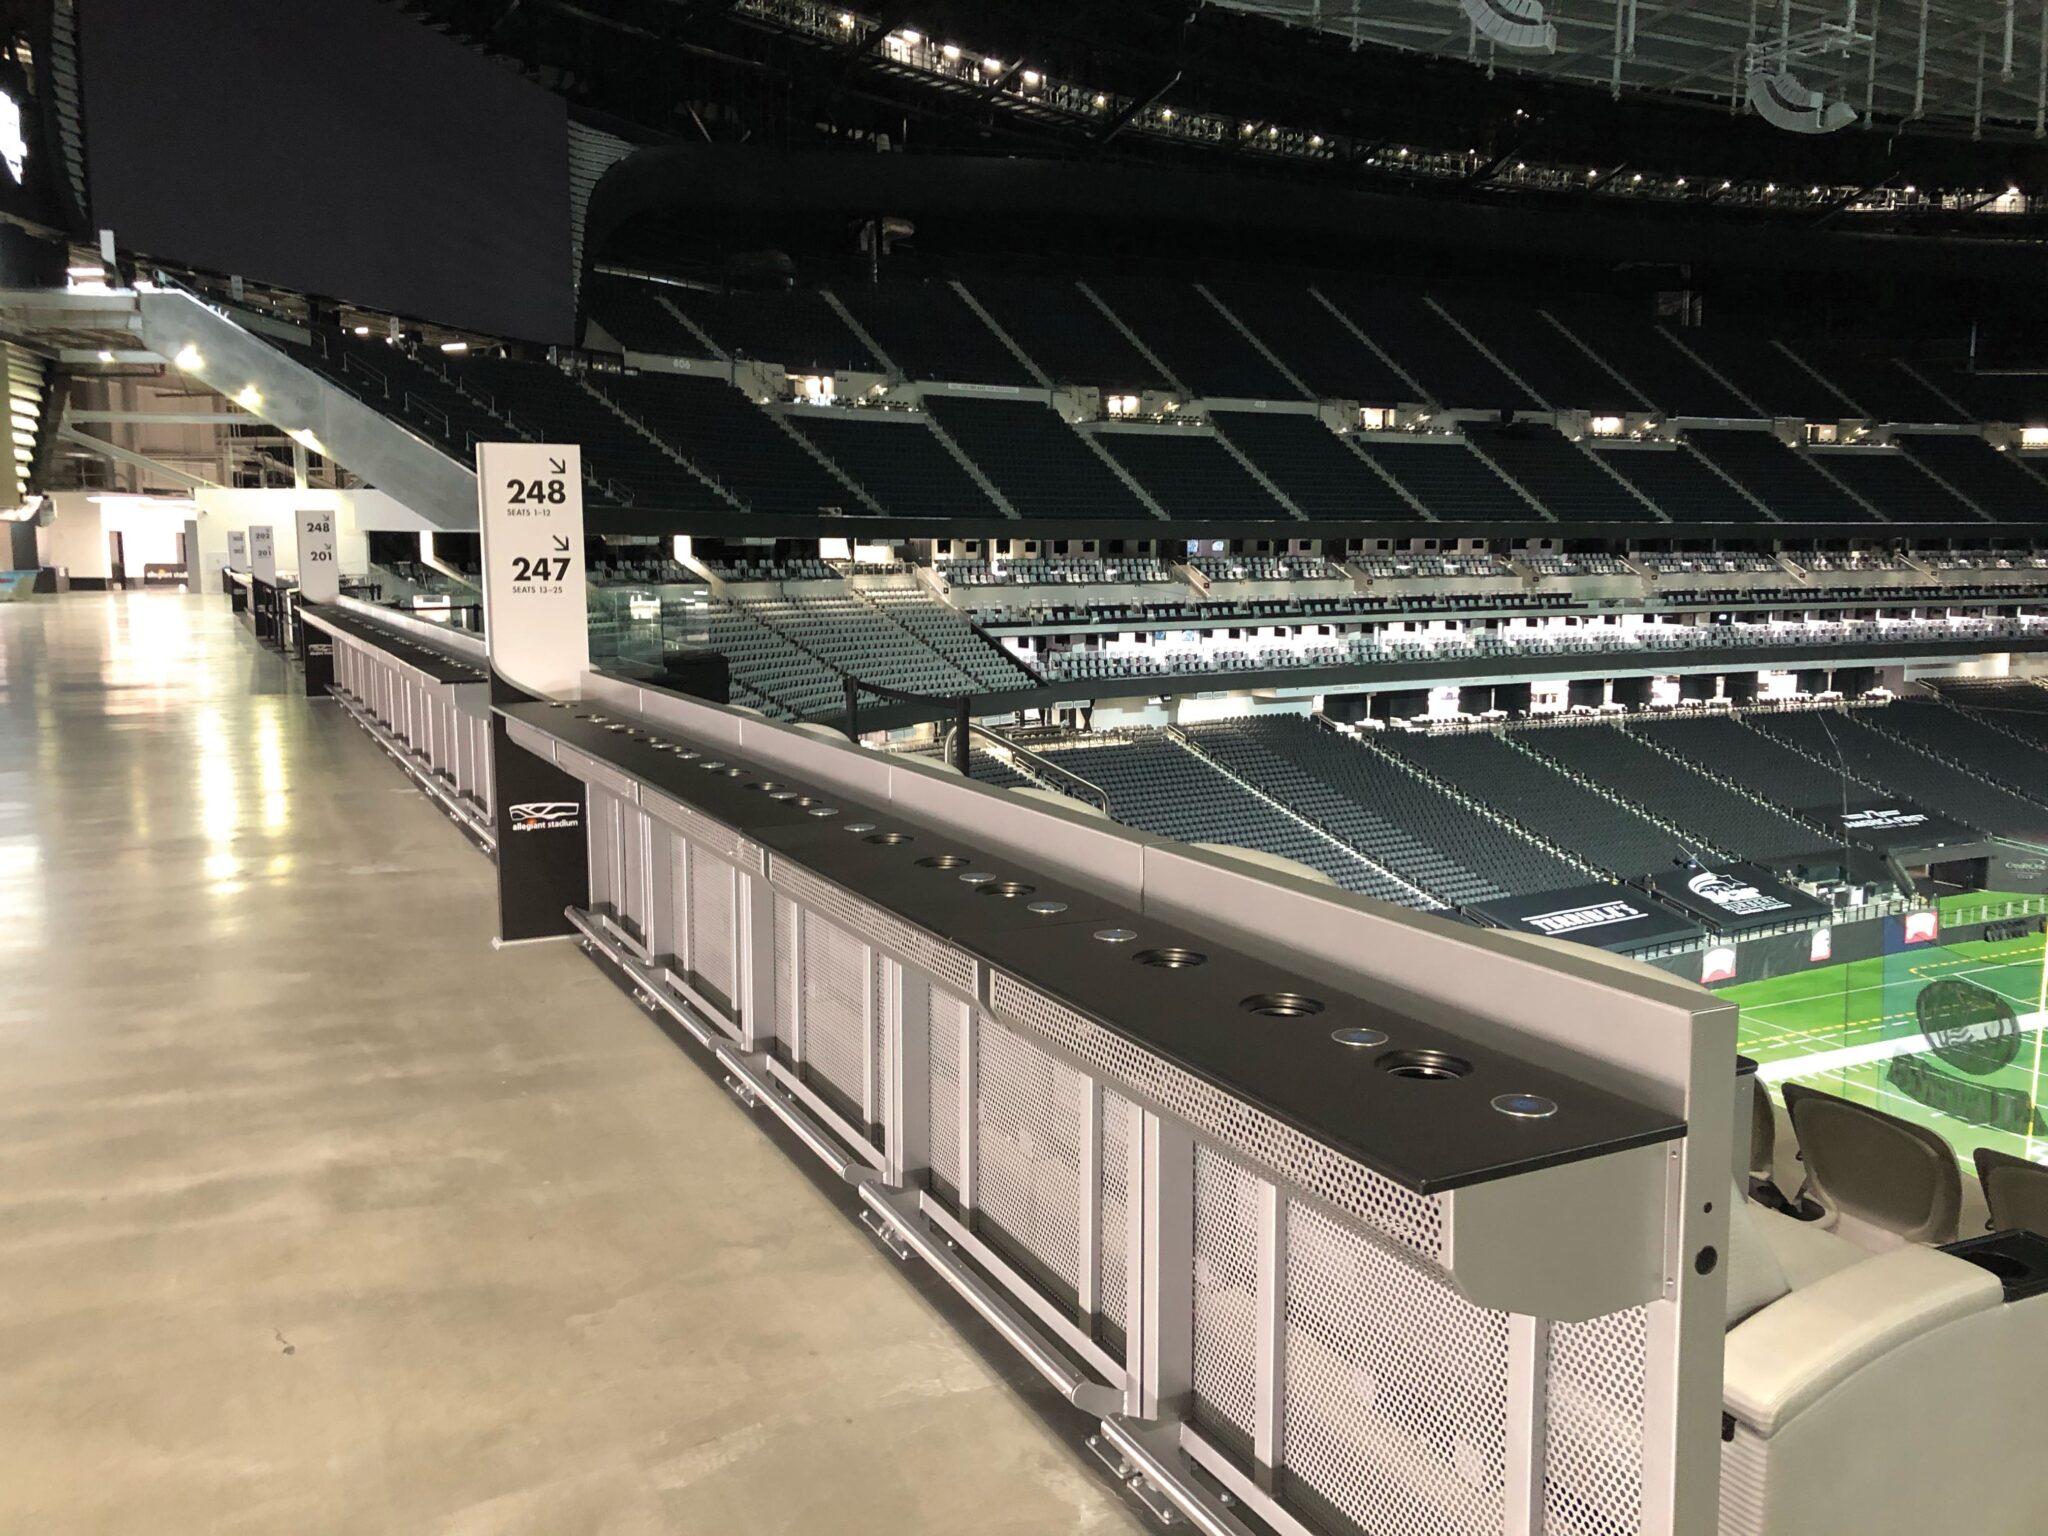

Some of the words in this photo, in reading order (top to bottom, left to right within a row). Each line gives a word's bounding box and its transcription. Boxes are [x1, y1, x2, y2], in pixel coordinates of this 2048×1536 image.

[506, 479, 566, 504] 248
[507, 509, 530, 517] SEATS
[534, 509, 551, 517] 1-12
[307, 522, 330, 533] 248
[311, 551, 332, 561] 201
[512, 557, 571, 582] 247
[512, 586, 536, 594] SEATS
[540, 586, 563, 594] 13-25
[513, 822, 545, 831] allegiant
[548, 819, 578, 828] stadium
[1529, 903, 1639, 931] TERRIBLE'S
